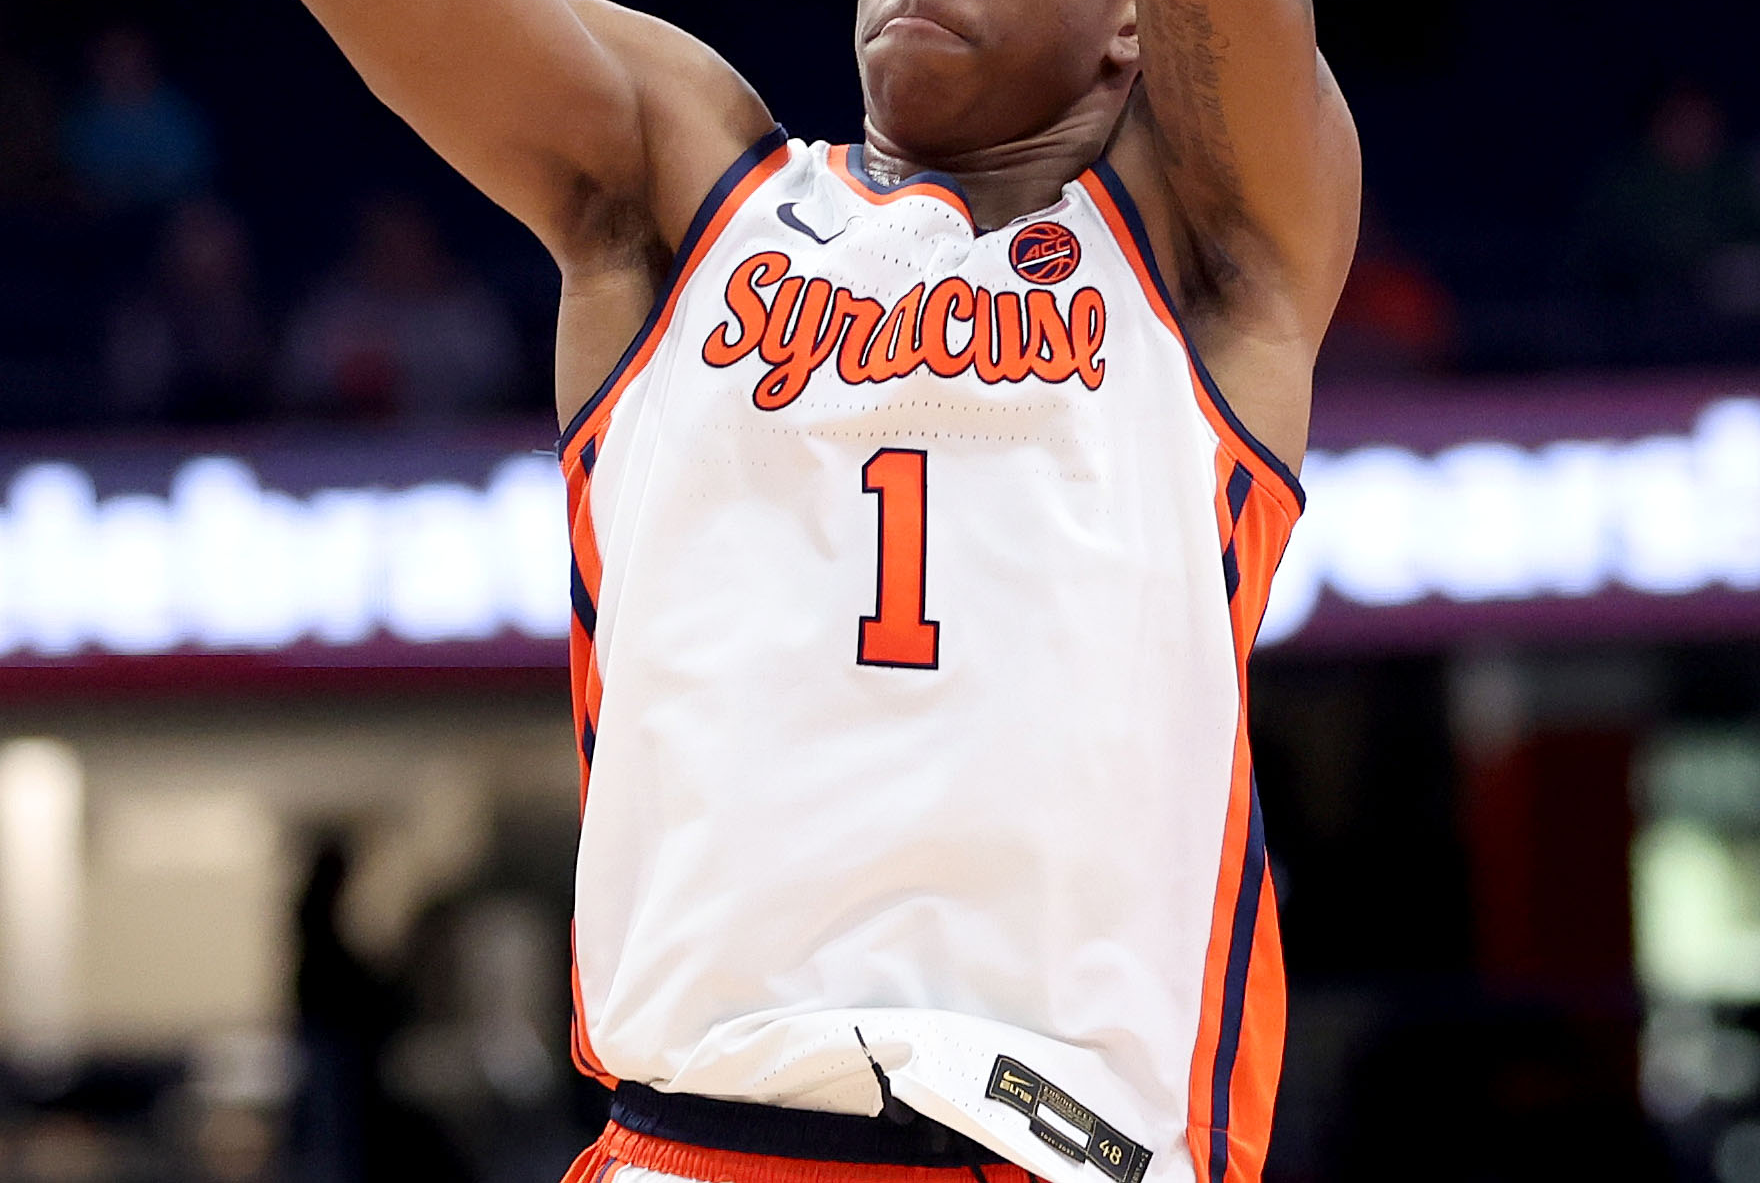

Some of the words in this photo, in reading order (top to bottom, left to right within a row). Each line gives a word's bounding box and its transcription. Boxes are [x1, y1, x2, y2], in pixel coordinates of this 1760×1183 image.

[1020, 235, 1071, 262] ACC
[702, 251, 1107, 412] Syracuse
[856, 447, 940, 670] 1
[1099, 1139, 1122, 1165] 48
